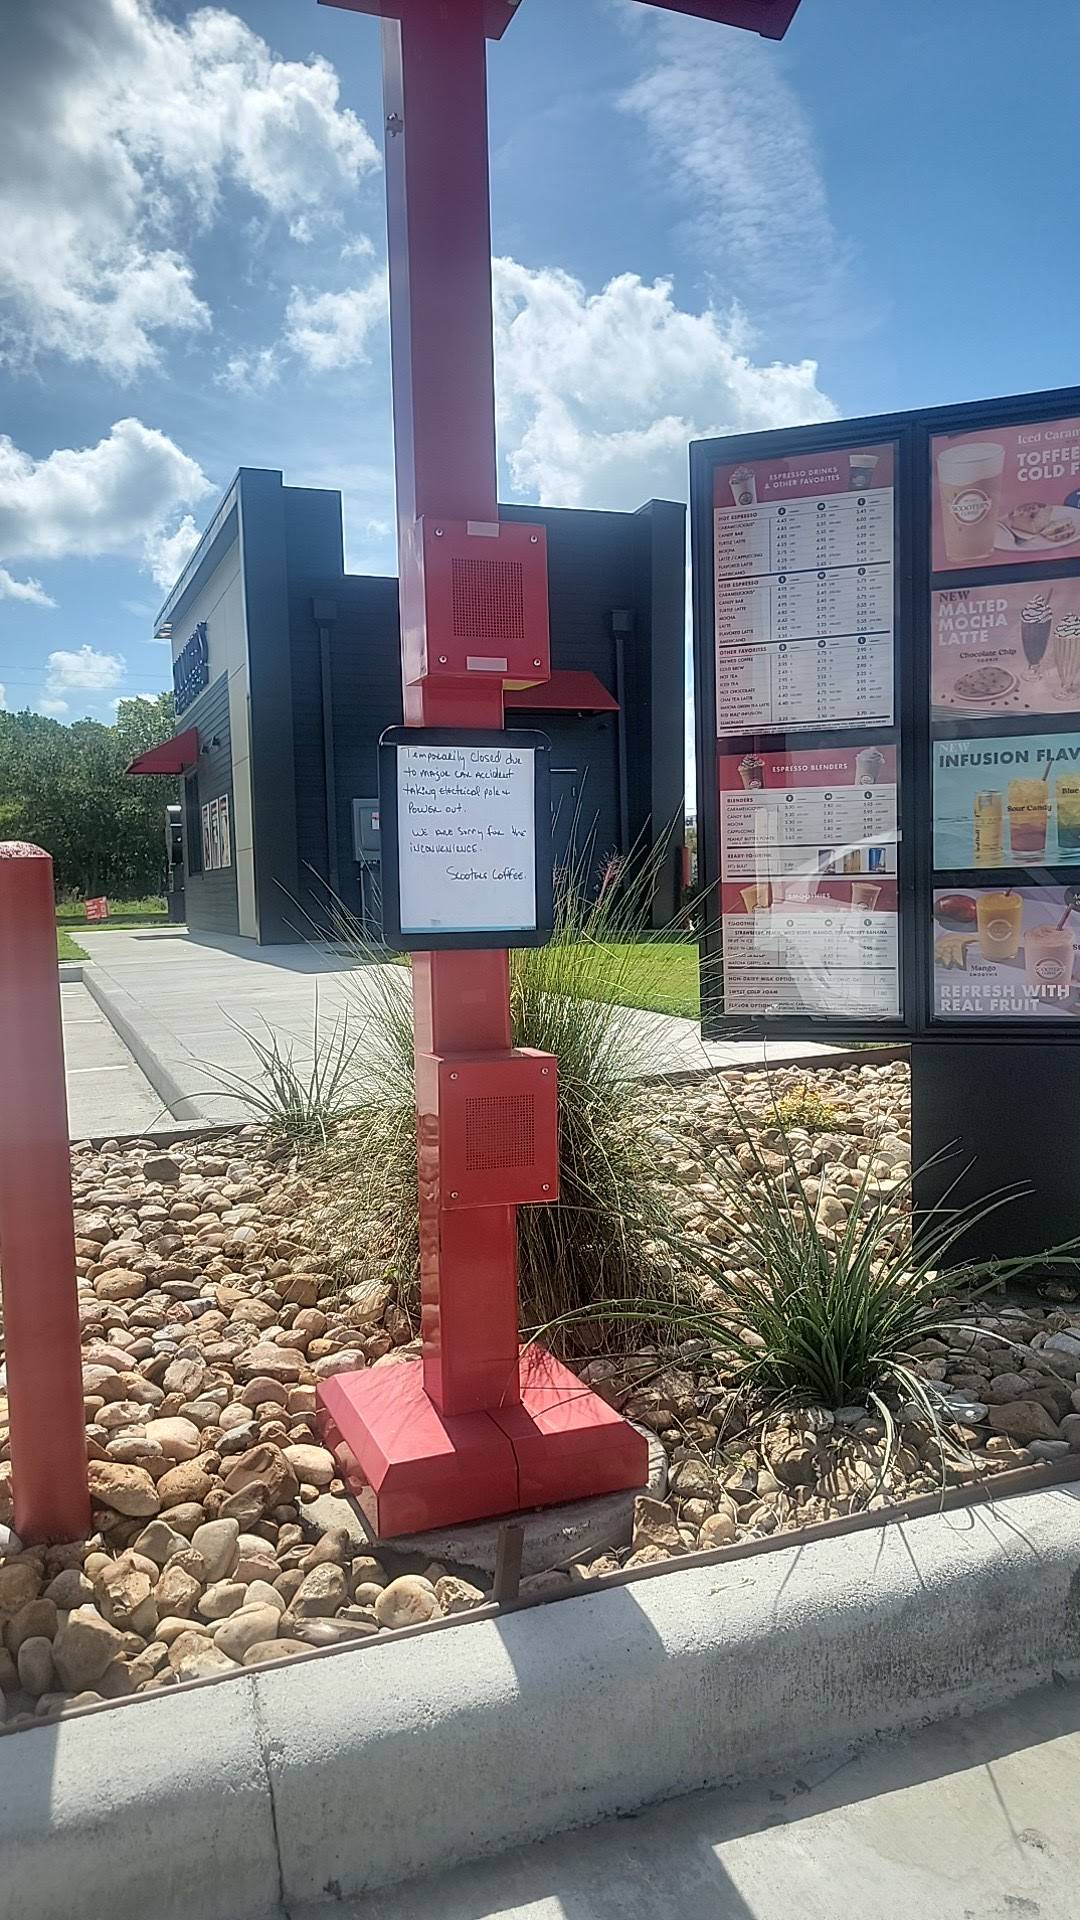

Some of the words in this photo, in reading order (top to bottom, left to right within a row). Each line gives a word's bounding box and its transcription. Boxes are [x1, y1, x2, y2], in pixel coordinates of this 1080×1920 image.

[1017, 433, 1041, 444] Iced
[769, 469, 806, 481] ESPRESSO
[808, 466, 838, 477] DRINKS
[1017, 464, 1065, 482] COLD
[773, 479, 797, 489] OTHER
[800, 474, 840, 485] FAVORITES
[939, 590, 970, 602] NEW
[940, 599, 1008, 617] MALTED
[940, 613, 1008, 631] MOCHA
[939, 630, 989, 646] LATTE
[960, 649, 997, 659] Chocolate
[998, 648, 1016, 657] Chip
[940, 742, 970, 752] NEW
[505, 752, 522, 765] due
[939, 750, 1029, 768] INFUSION
[404, 766, 417, 778] to
[772, 765, 808, 773] ESPRESSO
[811, 762, 848, 771] BLENDERS
[1007, 804, 1025, 812] Sour
[1027, 804, 1052, 812] Candy
